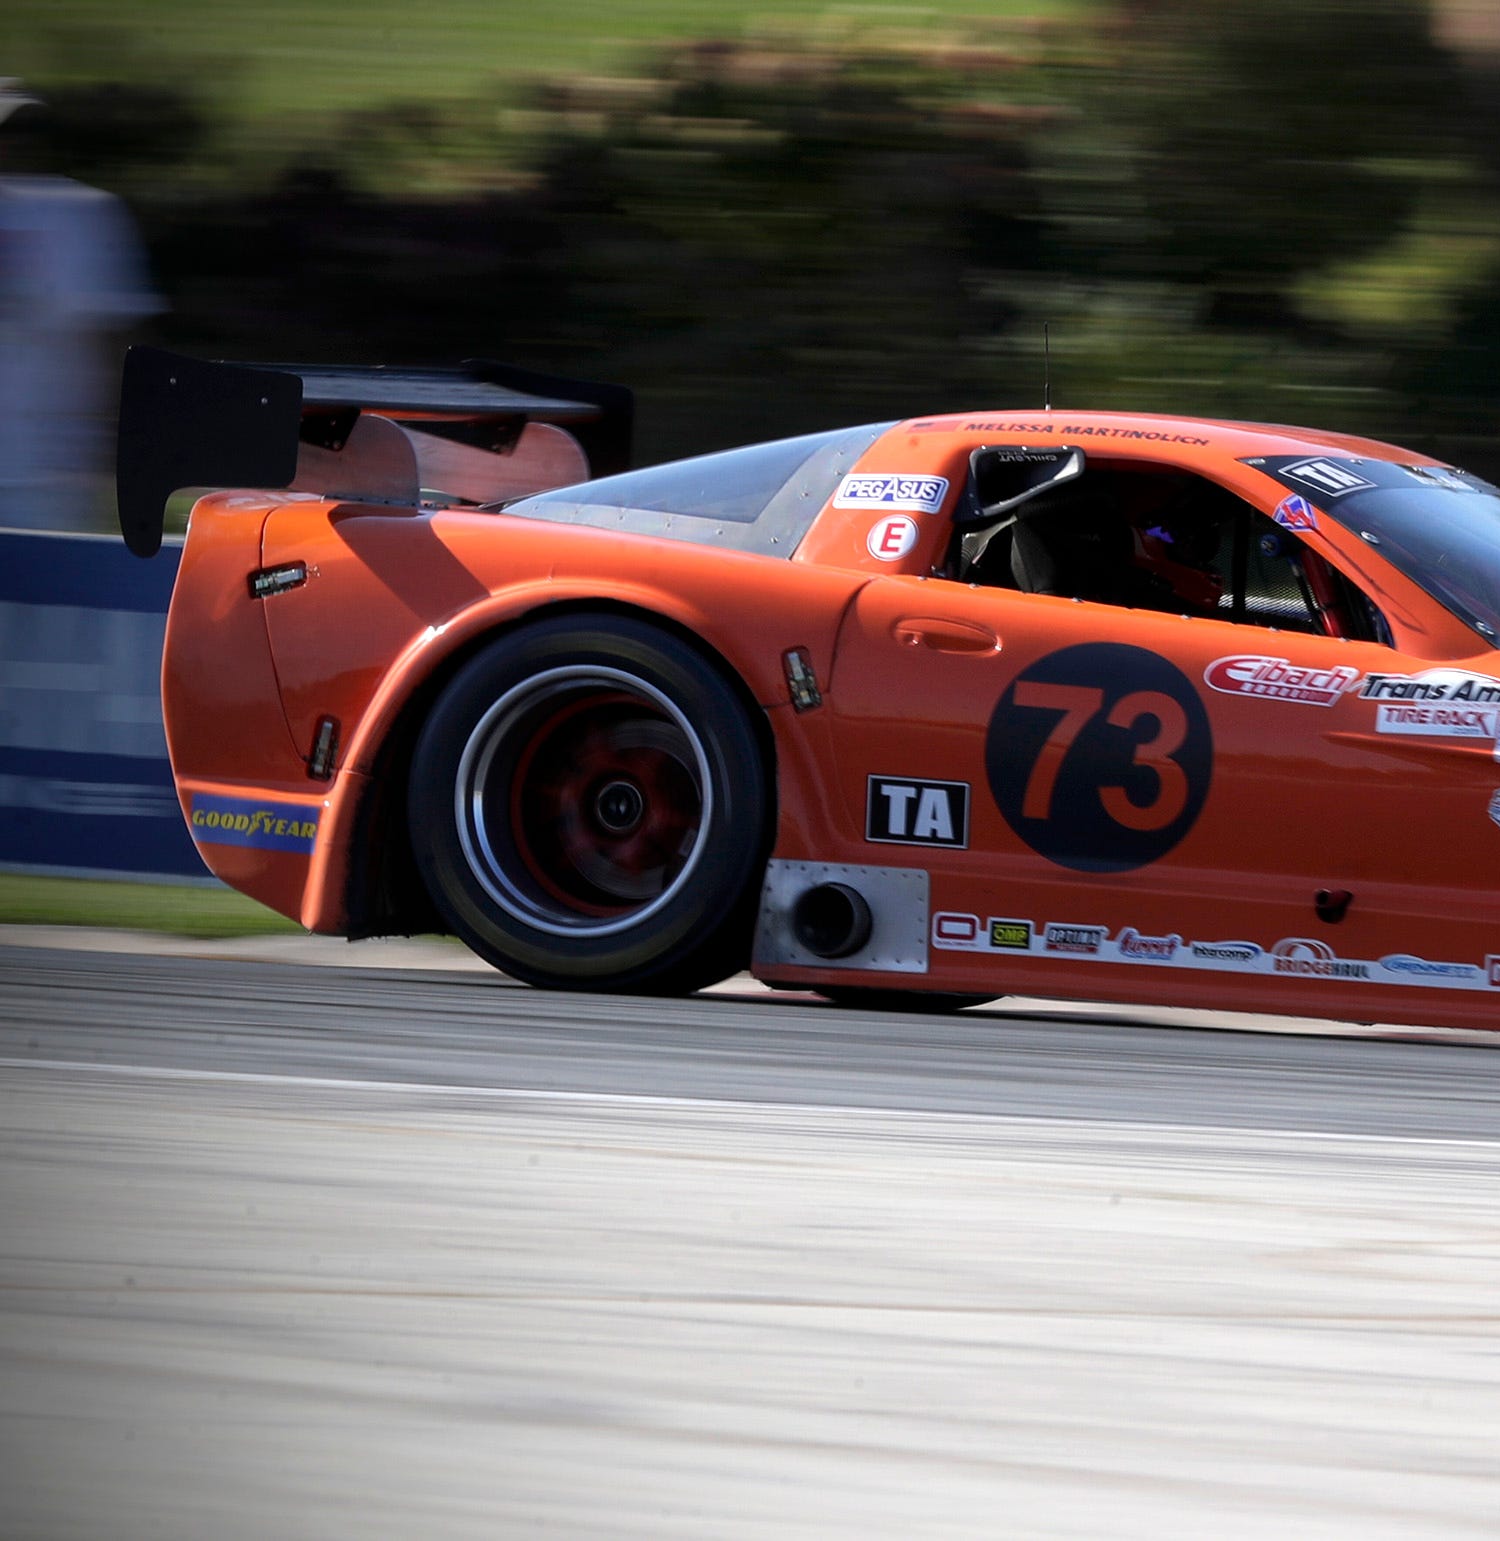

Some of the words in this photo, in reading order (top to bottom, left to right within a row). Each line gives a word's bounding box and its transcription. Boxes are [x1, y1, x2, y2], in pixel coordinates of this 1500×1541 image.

[964, 422, 1054, 434] MELISSA
[1060, 424, 1211, 447] MARTINOLICH
[843, 477, 938, 502] PEGASUS
[1291, 461, 1368, 490] TA
[879, 522, 907, 553] E
[1208, 658, 1351, 694] Eibach
[1363, 675, 1449, 701] Trans
[1384, 706, 1431, 725] TIRE
[1432, 708, 1492, 736] RACK
[1012, 680, 1190, 832] 73
[192, 809, 317, 839] GOODYEAR
[880, 783, 955, 840] TA
[993, 927, 1029, 944] OMP
